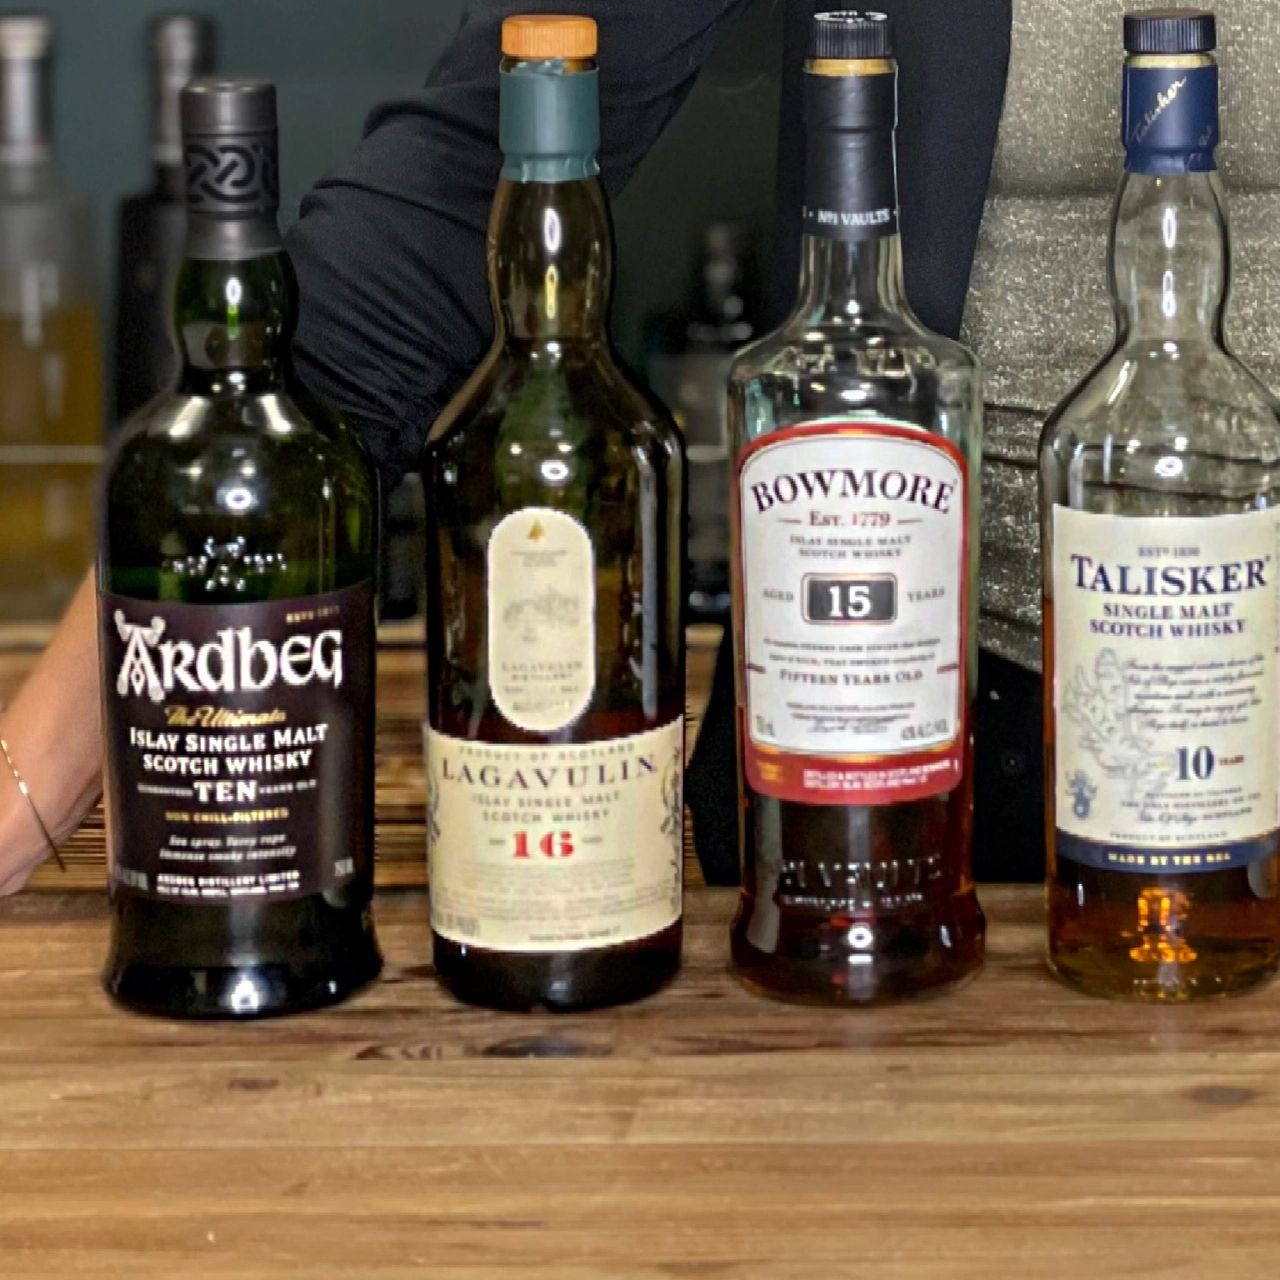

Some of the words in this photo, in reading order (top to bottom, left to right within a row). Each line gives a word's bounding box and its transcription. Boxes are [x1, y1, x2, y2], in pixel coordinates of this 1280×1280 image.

[840, 208, 891, 226] VAULTS
[750, 469, 955, 515] BOWMORE
[851, 511, 891, 528] 1779
[827, 536, 872, 547] SINGLE
[878, 535, 912, 546] MALT
[1071, 554, 1268, 596] TALISKER
[762, 588, 794, 602] AGED
[828, 584, 872, 618] 15
[907, 587, 946, 603] YEARS
[1103, 602, 1174, 620] SINGLE
[1180, 603, 1234, 620] MALT
[1090, 620, 1163, 638] SCOTCH
[1169, 620, 1246, 637] WHISKY
[779, 669, 838, 685] FIFTEEN
[843, 670, 890, 686] YEARS
[896, 669, 923, 682] OLD
[130, 726, 180, 752] ISLAY
[185, 731, 266, 753] SINGLE
[273, 723, 329, 748] MALT
[143, 753, 218, 776] SCOTCH
[225, 749, 312, 776] WHISKY
[442, 756, 658, 790] LAGAVULIN
[1176, 746, 1215, 781] 10
[193, 780, 258, 804] TEN
[473, 794, 511, 807] ISLAY
[519, 797, 572, 808] SINGLE
[582, 792, 620, 805] MALT
[482, 810, 543, 822] SCOTCH
[552, 810, 610, 822] WHISKY
[512, 830, 576, 860] 16
[1107, 852, 1145, 866] MADE
[1150, 855, 1169, 866] BY
